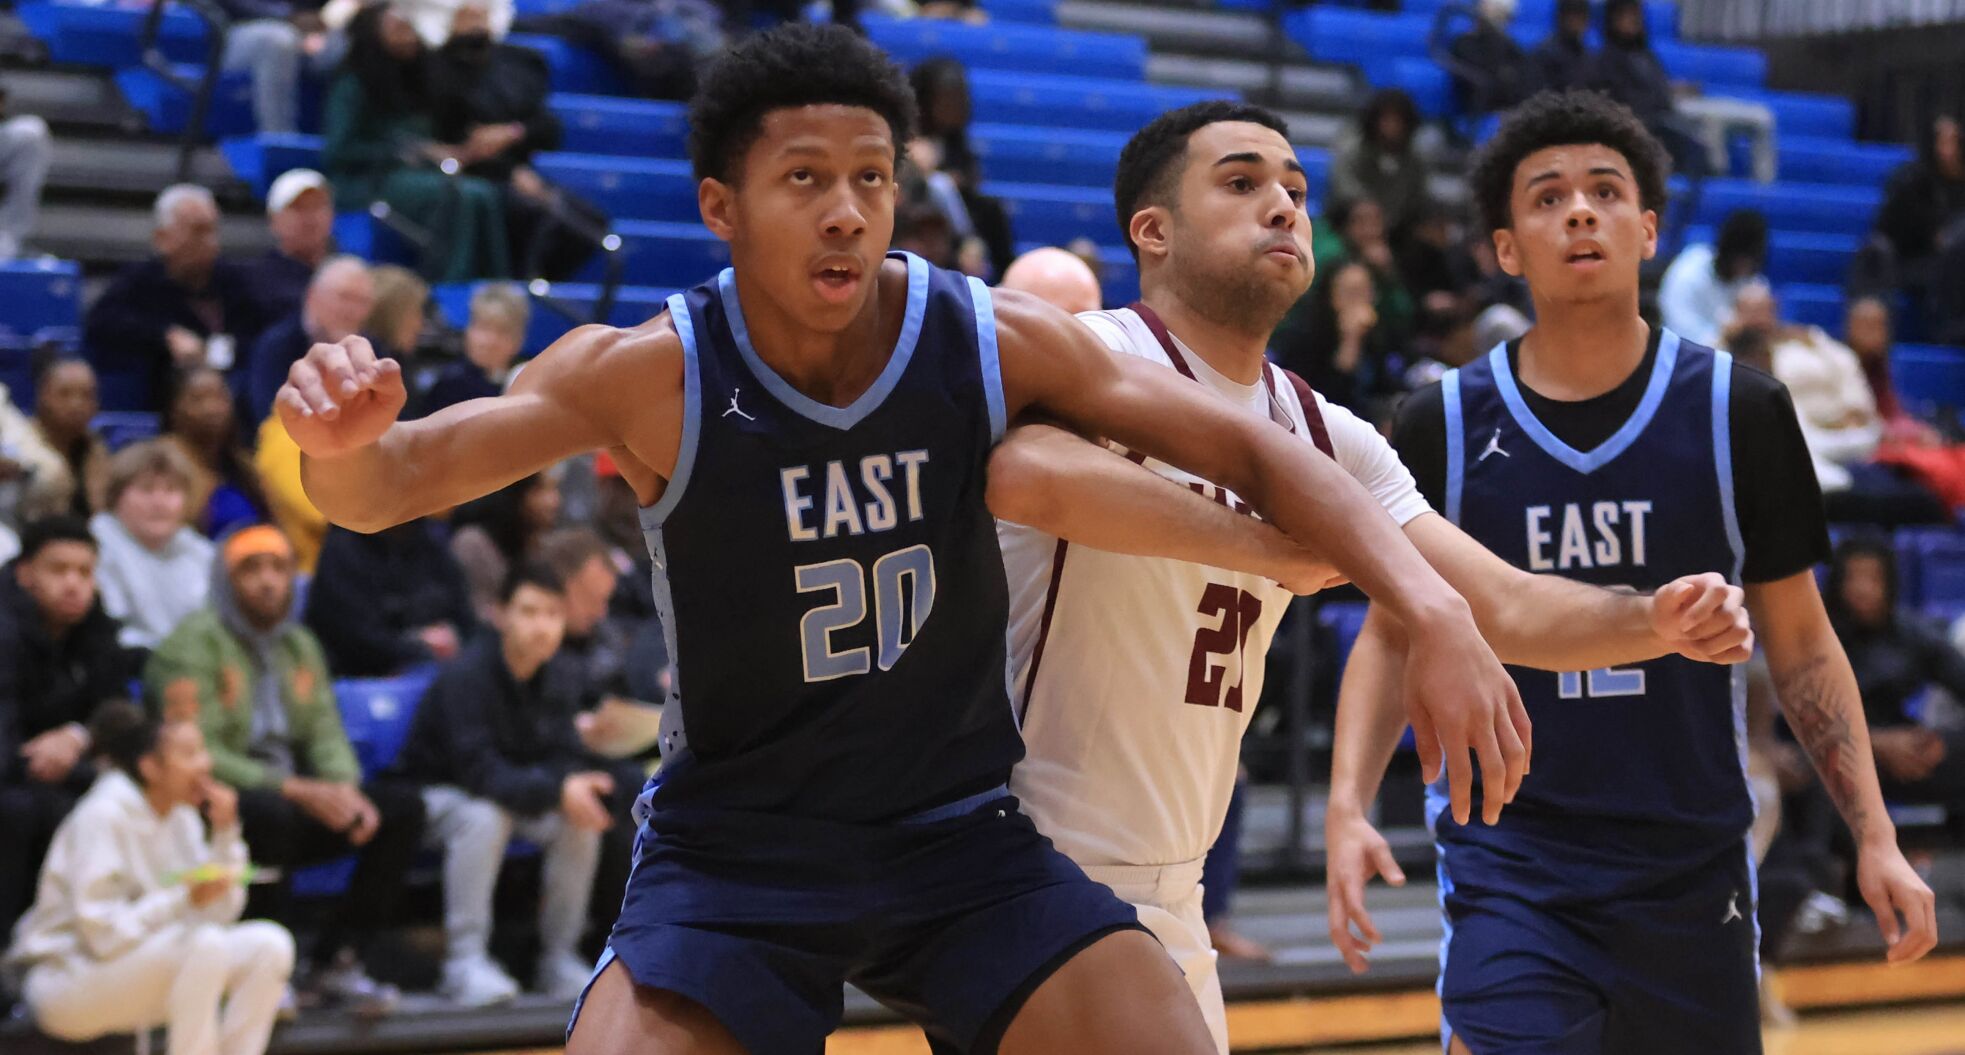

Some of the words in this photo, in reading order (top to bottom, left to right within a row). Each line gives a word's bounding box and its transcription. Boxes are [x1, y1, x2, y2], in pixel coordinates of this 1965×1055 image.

[779, 448, 930, 542] EAST
[1526, 500, 1653, 571] EAST
[794, 543, 936, 683] 20
